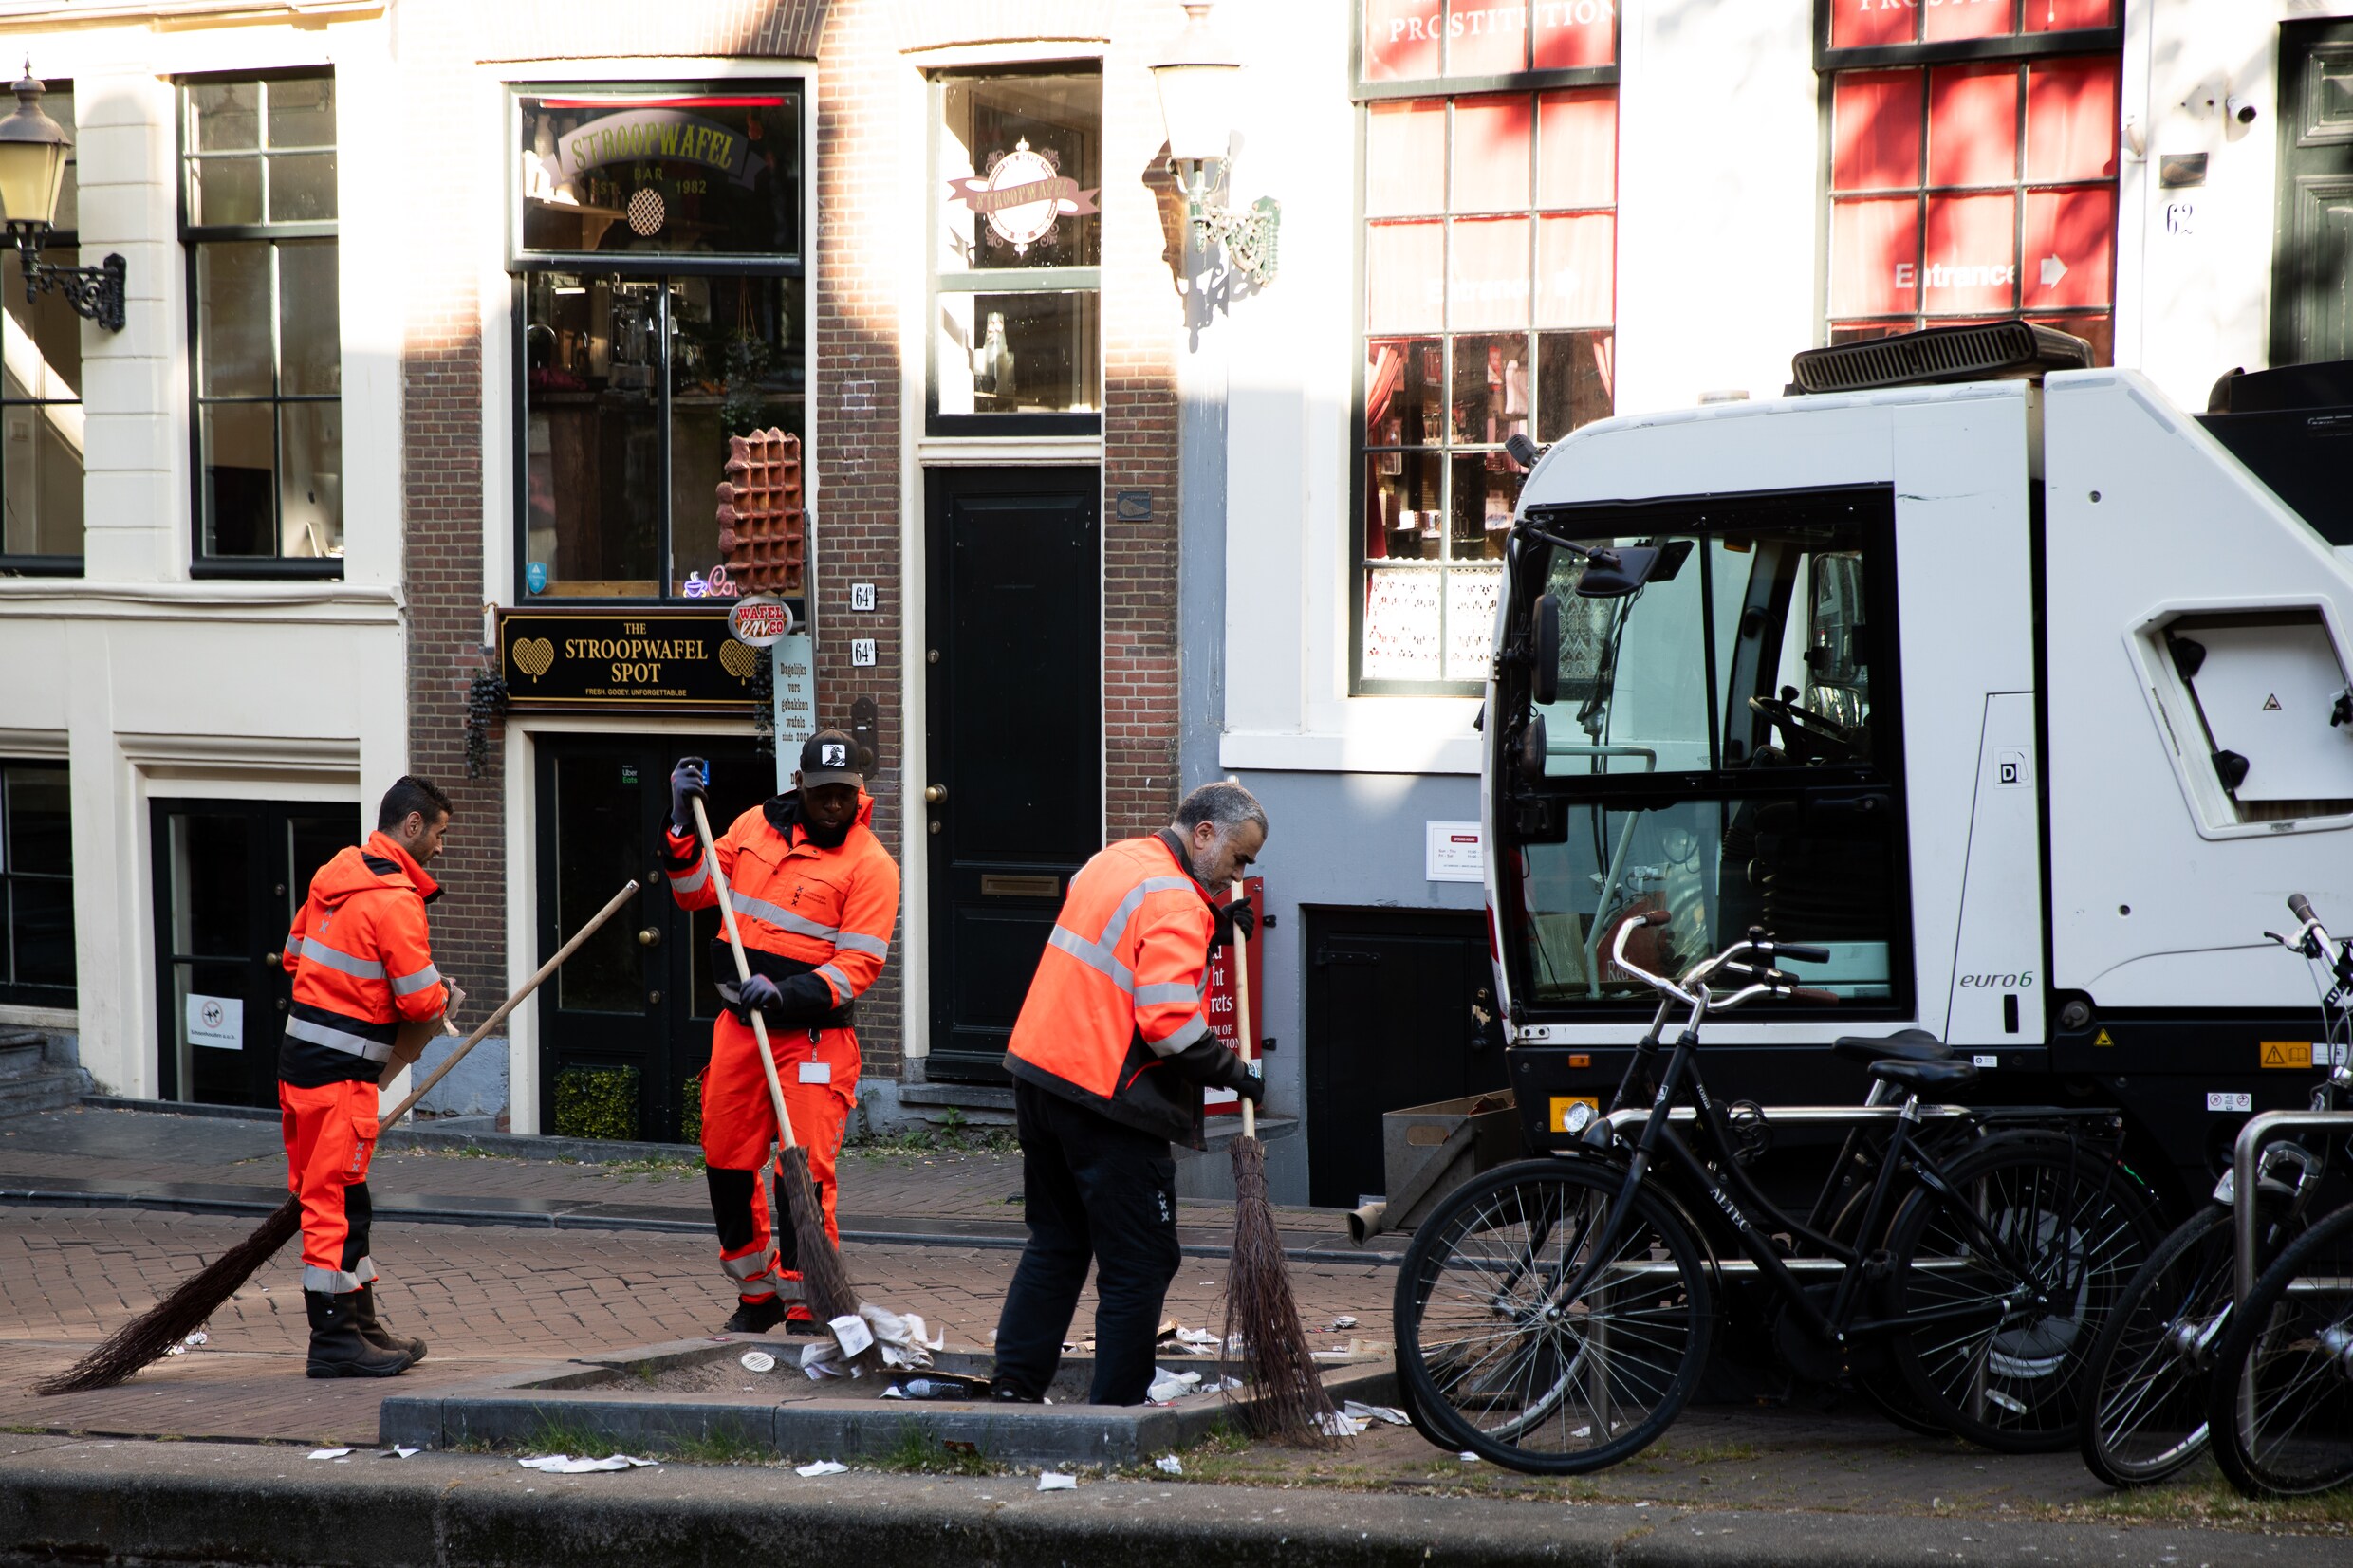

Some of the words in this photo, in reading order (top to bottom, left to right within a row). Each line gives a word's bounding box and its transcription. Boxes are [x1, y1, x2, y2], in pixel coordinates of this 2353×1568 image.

[571, 121, 734, 171] STROOPWAFEL
[634, 167, 663, 181] BAR
[675, 180, 707, 194] 1982
[2166, 203, 2194, 235] 62
[738, 605, 784, 620] WAFEL
[623, 622, 647, 635] THE
[769, 619, 784, 635] CO
[565, 638, 709, 660] STROOPWAFEL
[611, 662, 661, 683] SPOT
[780, 662, 807, 678] Dagelijks
[585, 688, 607, 696] FRESH.
[608, 688, 630, 696] GOOEY.
[787, 683, 801, 693] vers
[781, 697, 809, 712] gebakken
[786, 716, 806, 729] wafels
[782, 732, 793, 742] sinds
[622, 776, 639, 784] Eats
[2002, 766, 2015, 781] D
[1959, 970, 2033, 988] euro6
[1222, 1024, 1232, 1035] OF
[1710, 1188, 1751, 1233] ALTEC
